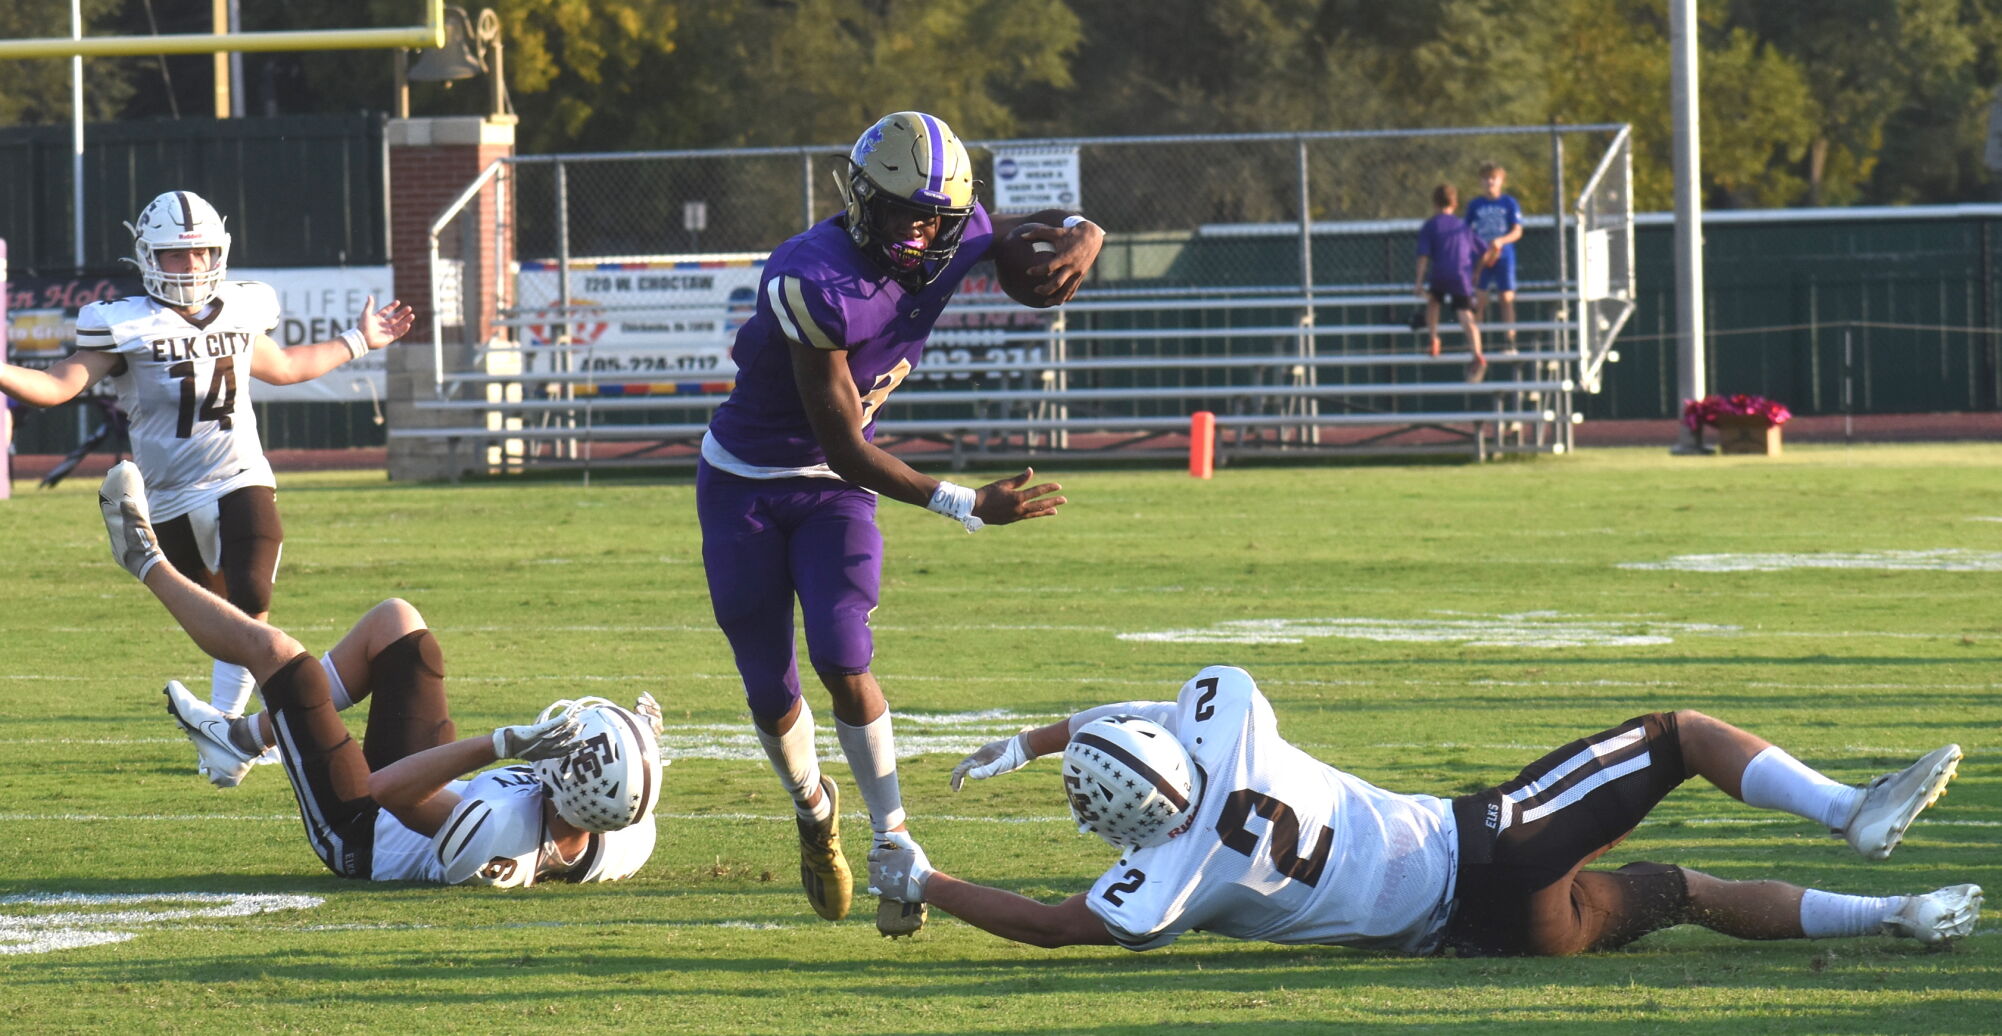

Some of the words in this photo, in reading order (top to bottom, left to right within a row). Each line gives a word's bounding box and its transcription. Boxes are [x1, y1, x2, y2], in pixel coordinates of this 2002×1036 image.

[584, 277, 611, 292] 720
[637, 275, 714, 291] CHOCTAW
[281, 287, 385, 316] LIFET
[284, 317, 361, 346] DEN
[152, 337, 201, 362] ELK
[206, 332, 250, 357] CITY
[169, 355, 237, 439] 14
[1194, 676, 1220, 723] 2
[1485, 803, 1500, 830] ELKS
[1215, 787, 1335, 889] 2
[1101, 868, 1146, 908] 2
